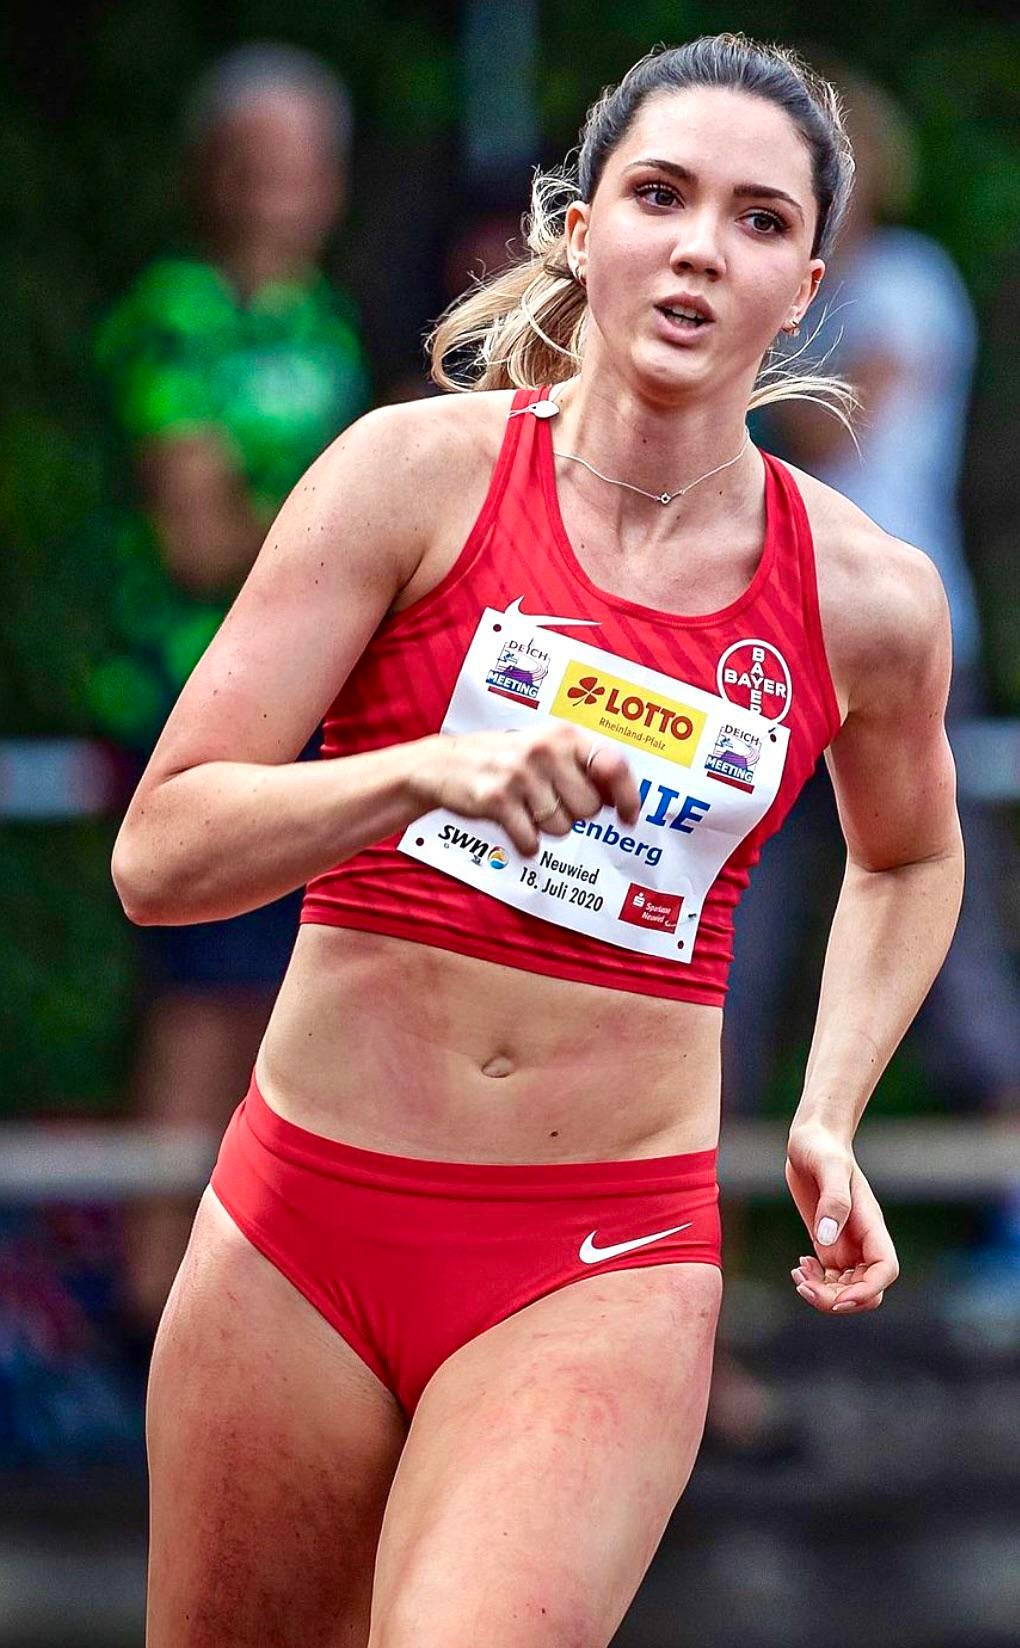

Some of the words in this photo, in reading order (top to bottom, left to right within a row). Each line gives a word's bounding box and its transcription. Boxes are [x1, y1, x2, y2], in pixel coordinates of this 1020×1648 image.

[509, 639, 549, 661] DEICH
[487, 670, 539, 699] MEETING
[724, 667, 787, 699] BAYER
[605, 688, 694, 741] LOTTO
[599, 717, 667, 751] Rheinland-Pfalz
[724, 724, 760, 746] DEICH
[706, 755, 754, 783] MEETING
[438, 824, 490, 858] swn
[540, 850, 600, 885] Neuwied
[519, 866, 539, 890] 18.
[541, 878, 569, 901] Juli
[569, 887, 604, 912] 2020
